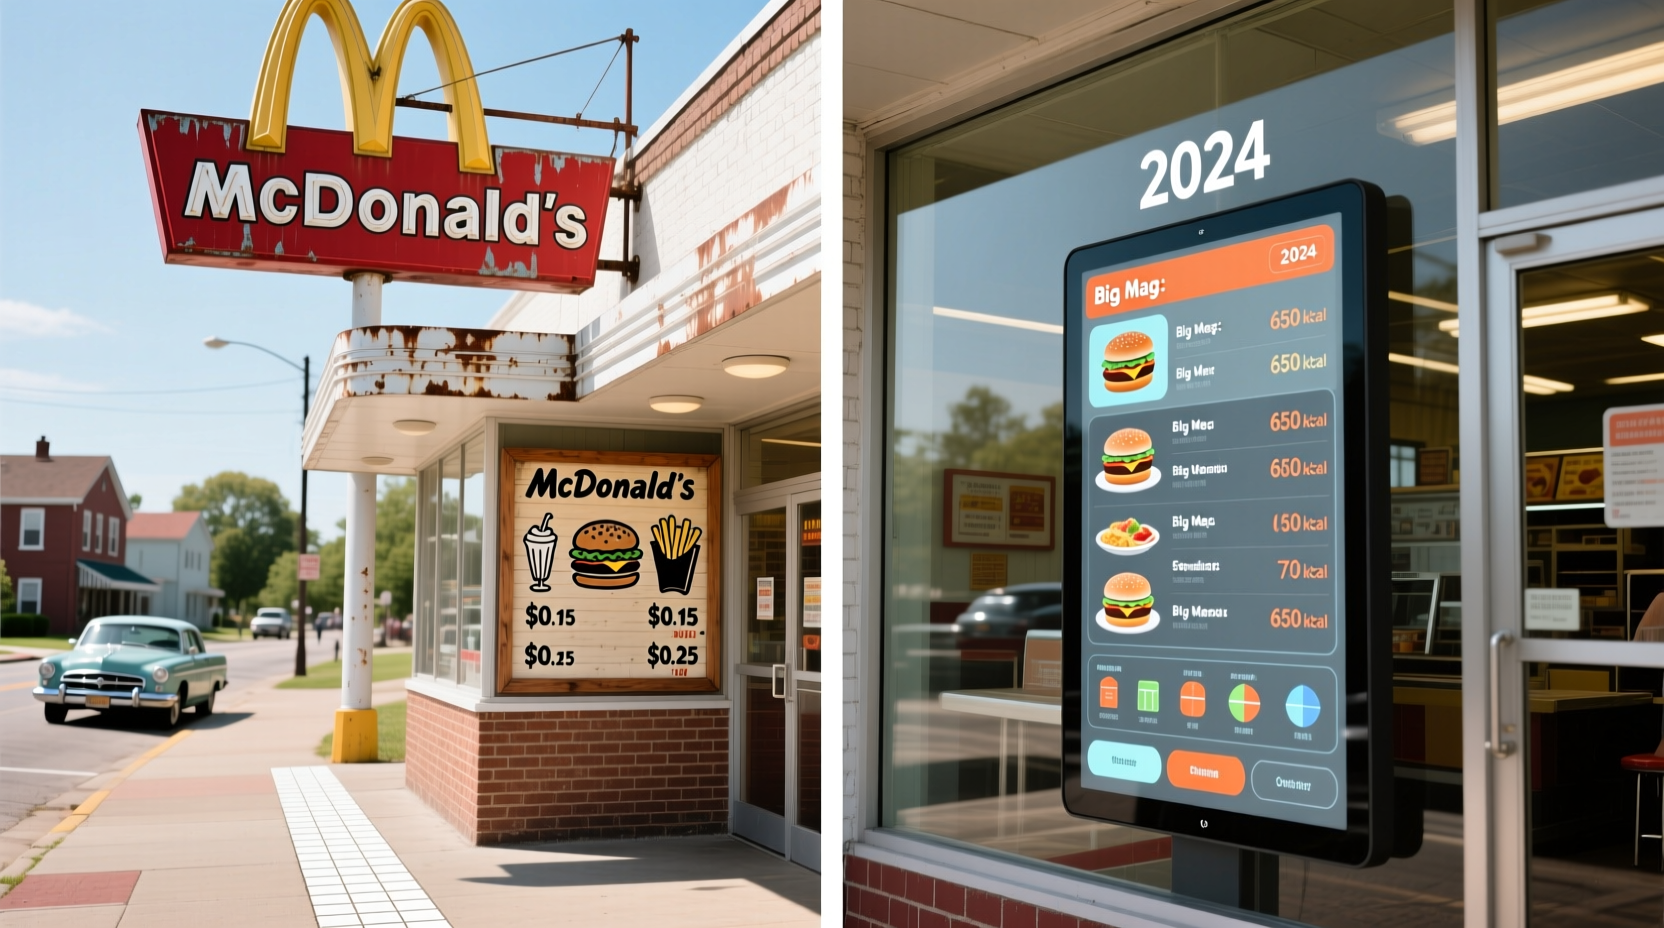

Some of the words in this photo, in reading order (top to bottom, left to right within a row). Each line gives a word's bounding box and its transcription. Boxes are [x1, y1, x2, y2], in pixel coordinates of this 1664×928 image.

[1140, 119, 1270, 210] 2024
[184, 160, 588, 250] McDonald's
[1280, 243, 1317, 265] 2024
[1094, 283, 1120, 307] Big
[1125, 278, 1166, 300] Mag:
[1270, 307, 1300, 330] 650
[1176, 324, 1192, 341] Big
[1270, 352, 1300, 374] 650
[1270, 410, 1300, 432] 650
[525, 467, 695, 501] McDonald's
[1277, 559, 1301, 580] 70
[525, 601, 576, 630] $0.15
[648, 602, 698, 629] $0.15
[1172, 604, 1189, 621] Big
[1270, 608, 1301, 628] 650
[524, 641, 575, 670] $0.25
[647, 641, 698, 669] $0.25
